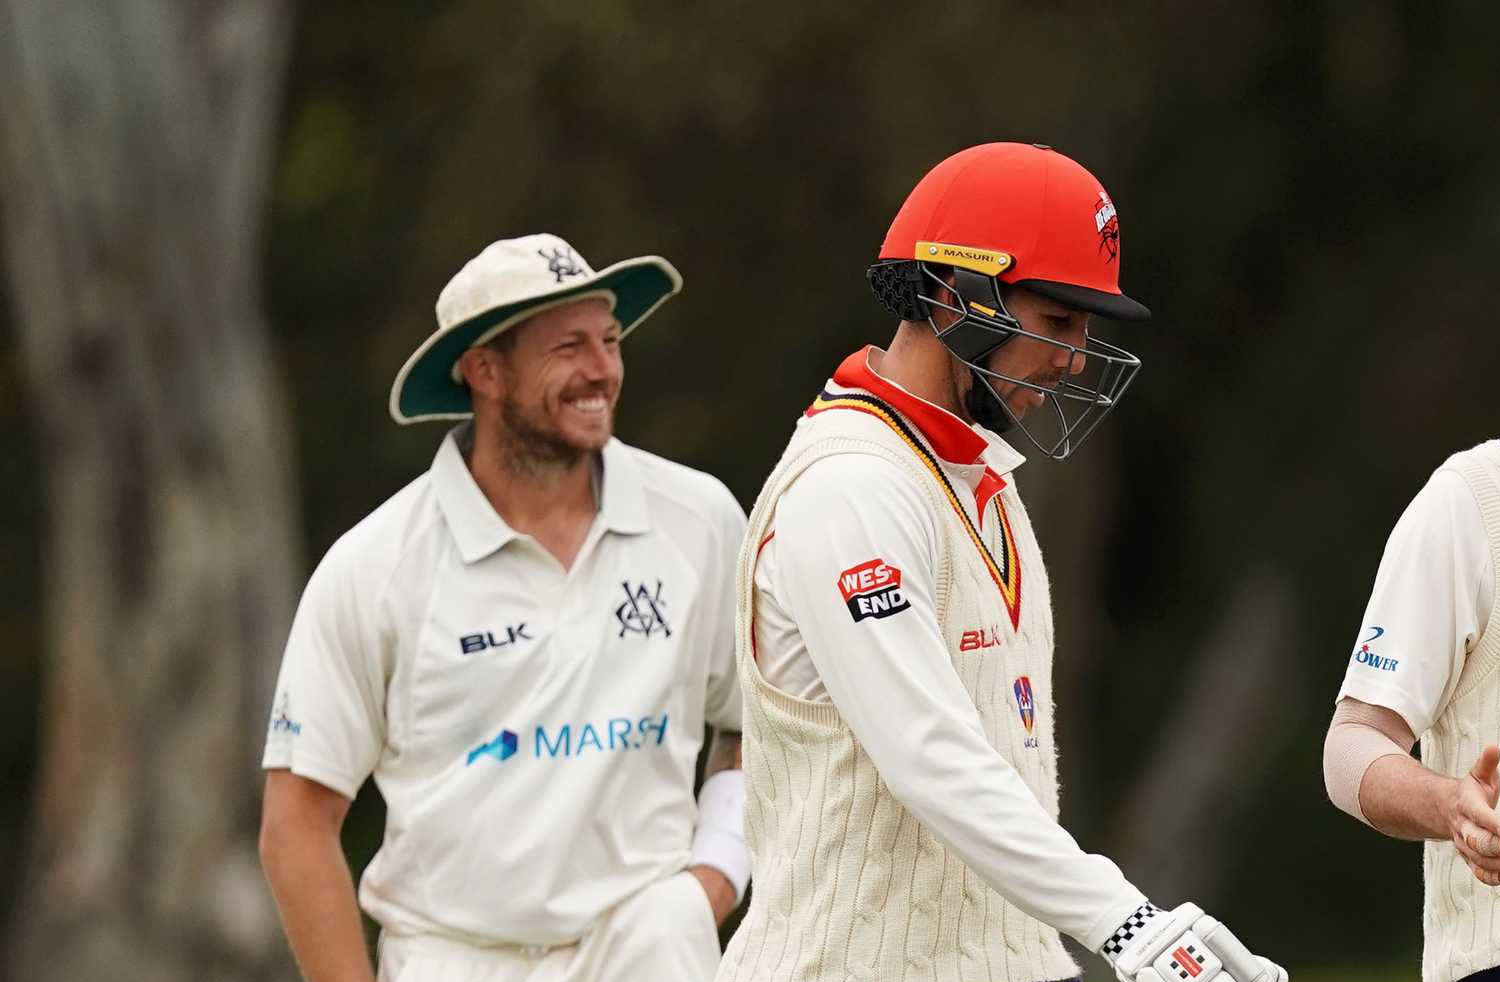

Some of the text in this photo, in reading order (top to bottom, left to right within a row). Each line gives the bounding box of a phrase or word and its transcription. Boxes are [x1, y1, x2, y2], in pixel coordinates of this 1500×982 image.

[944, 249, 994, 262] MASURI
[841, 564, 893, 593] WES
[857, 589, 907, 614] END
[460, 623, 534, 654] BLK
[960, 625, 1000, 651] BLK
